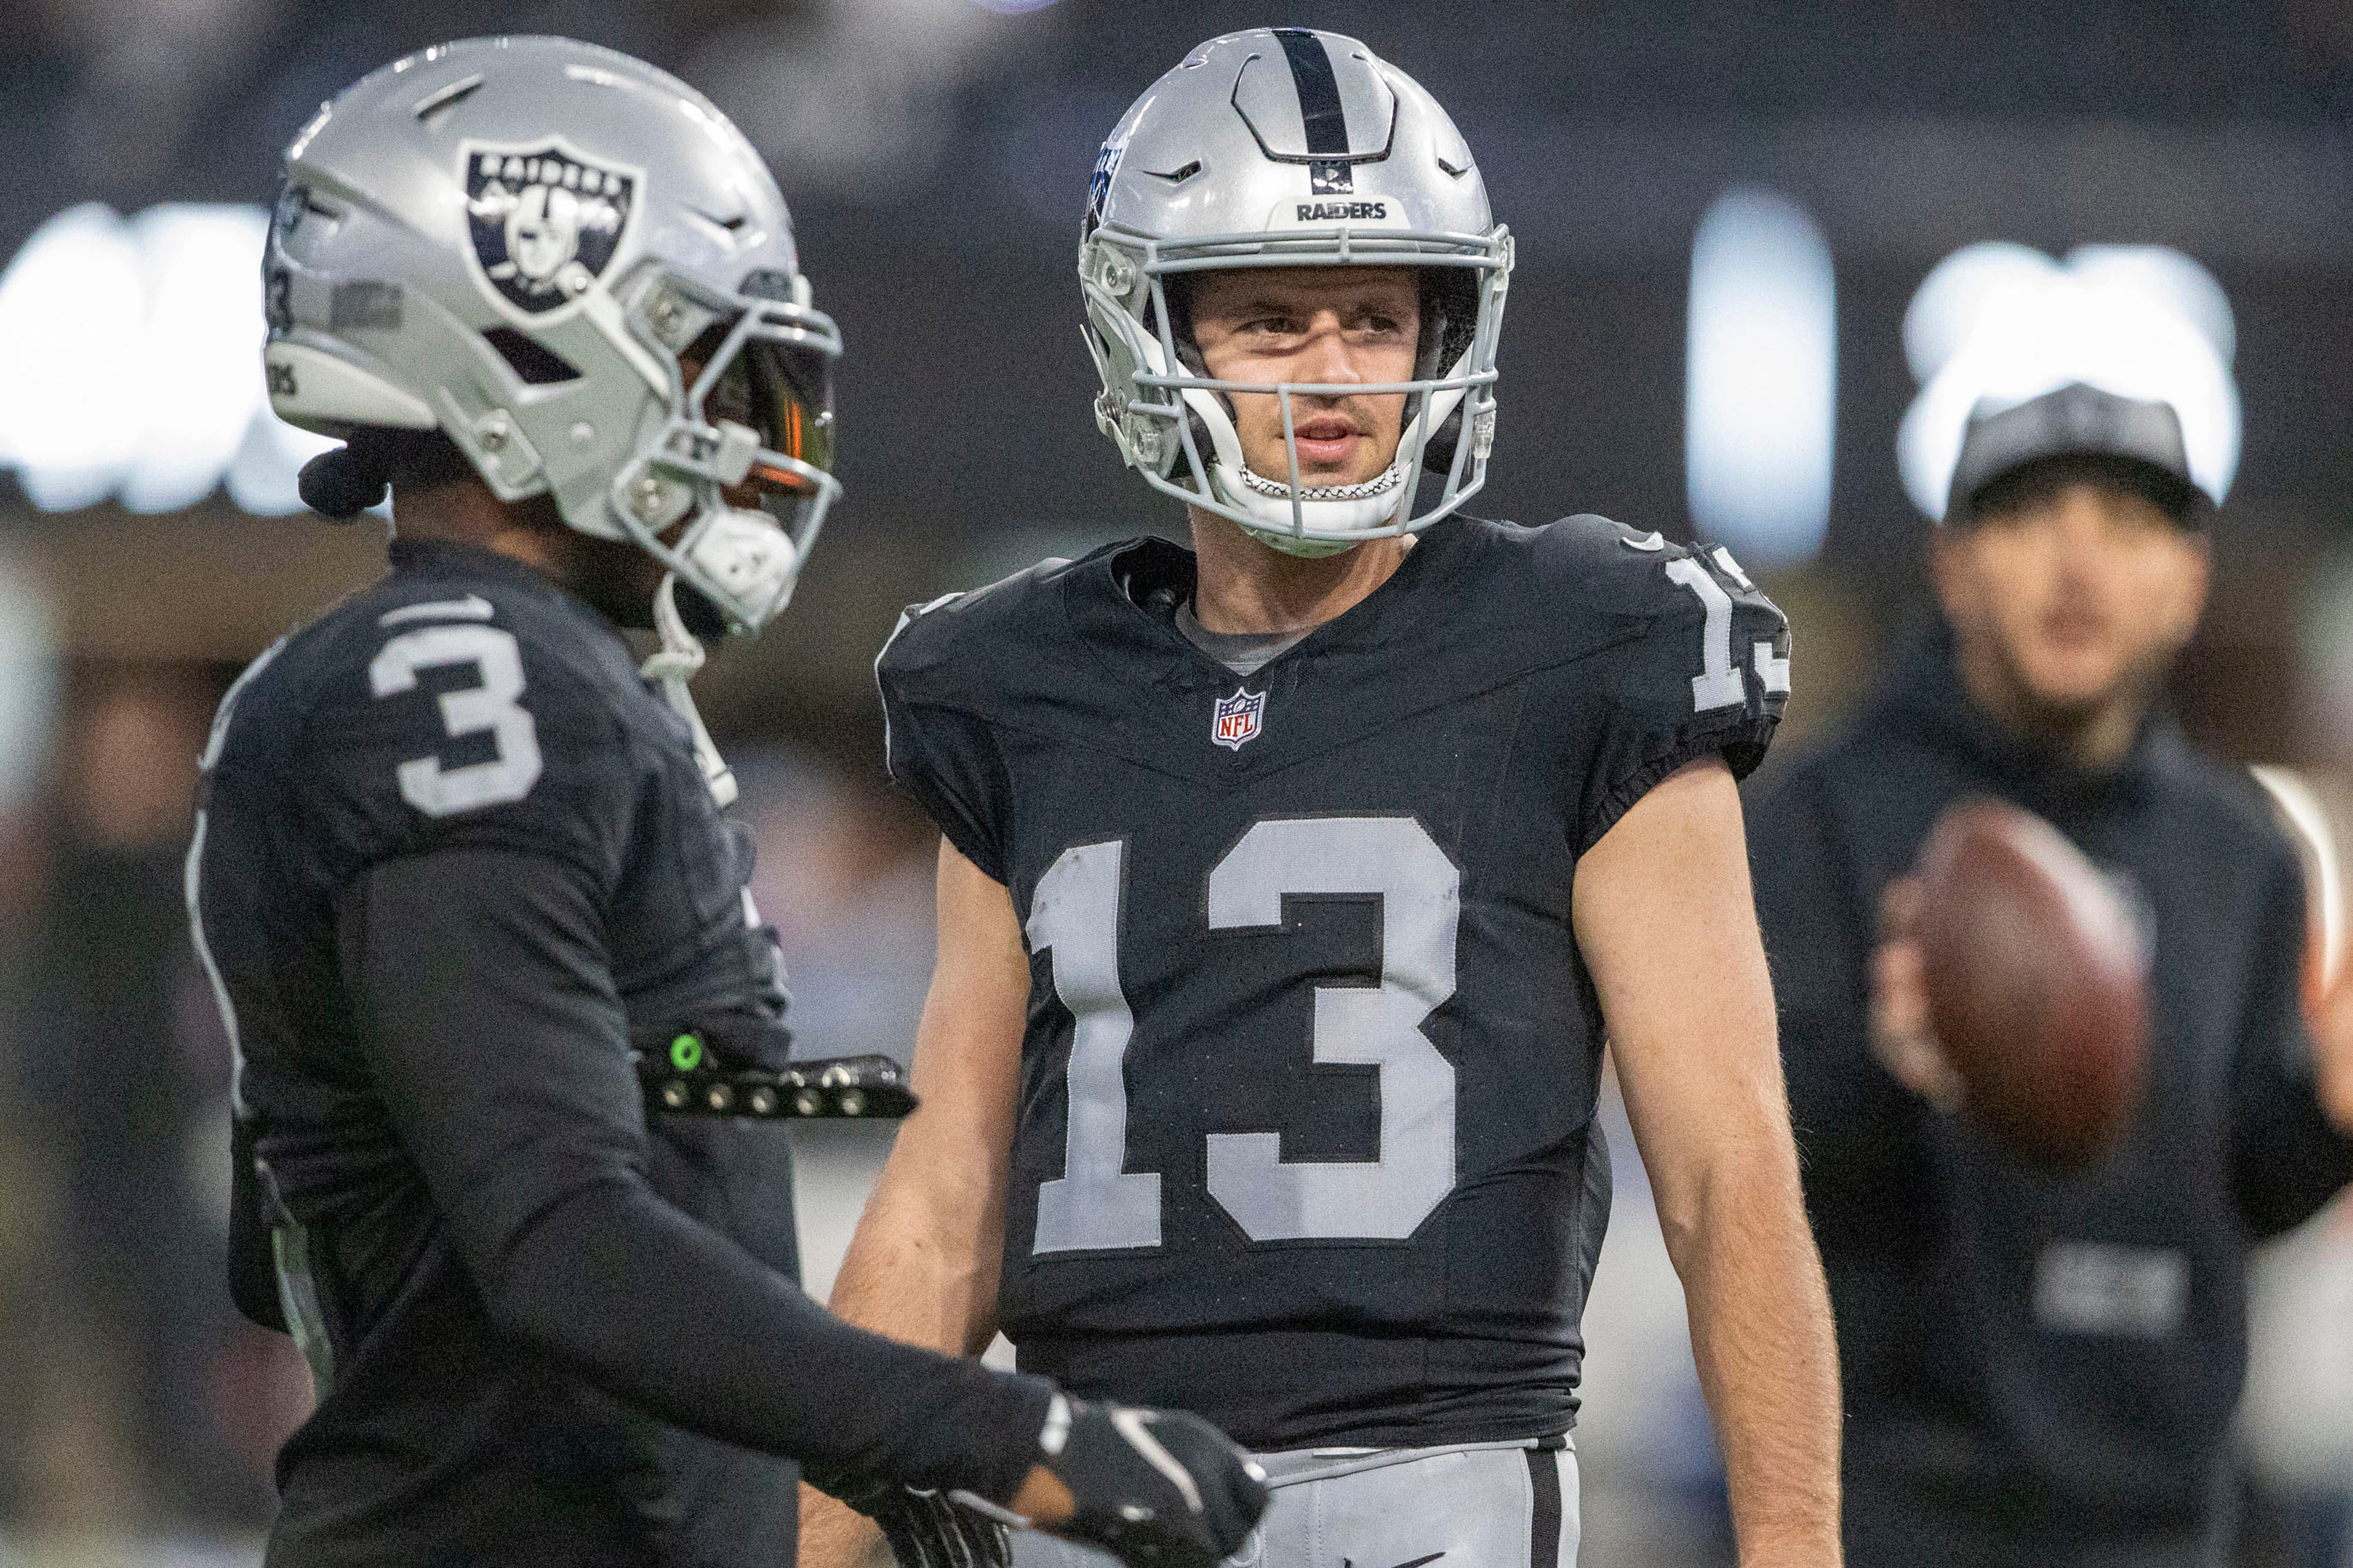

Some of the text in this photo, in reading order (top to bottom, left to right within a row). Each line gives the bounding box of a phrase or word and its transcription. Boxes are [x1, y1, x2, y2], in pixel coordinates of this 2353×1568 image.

[1297, 202, 1387, 221] RAIDERS
[369, 623, 542, 818] 3
[1219, 713, 1253, 737] NFL
[1025, 817, 1461, 1254] 13
